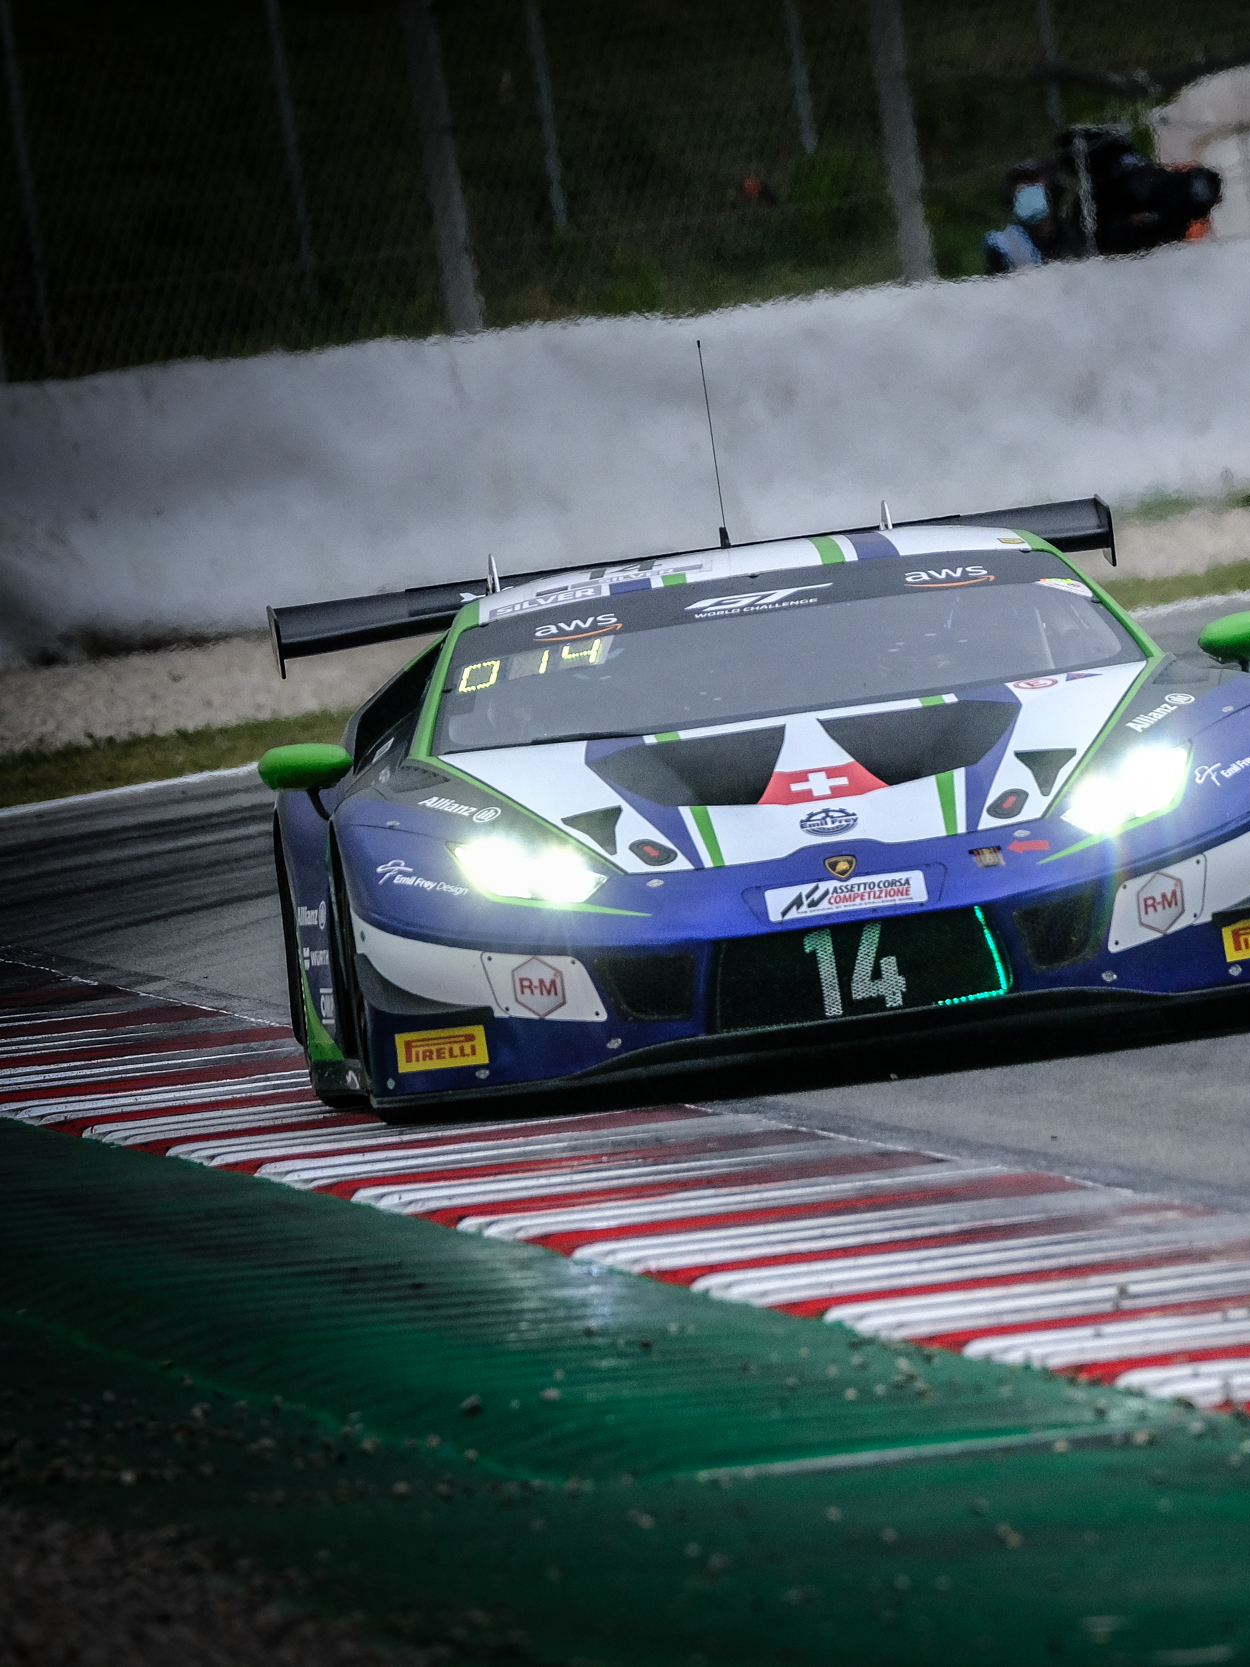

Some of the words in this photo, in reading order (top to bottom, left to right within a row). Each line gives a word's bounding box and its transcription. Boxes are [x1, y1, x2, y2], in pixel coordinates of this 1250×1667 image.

[598, 568, 675, 584] SILVER
[905, 565, 988, 583] aws
[496, 587, 596, 616] SILVER
[694, 607, 740, 619] WORLD
[743, 597, 818, 612] CHALLENGE
[534, 613, 618, 637] aws
[1125, 702, 1178, 733] Allianz
[1220, 762, 1242, 779] Emil
[418, 796, 478, 816] Allianz
[801, 819, 828, 829] Emil
[830, 816, 859, 825] Frey
[393, 874, 417, 885] Emil
[414, 877, 437, 892] Frey
[436, 881, 469, 896] Design
[831, 881, 876, 895] ASSETTO
[876, 878, 911, 891] CORSA
[828, 886, 911, 906] COMPETIZIONE
[1143, 889, 1179, 915] R-M
[803, 920, 907, 1017] 14
[518, 977, 558, 997] R-M
[403, 1033, 477, 1064] PIRELLI
